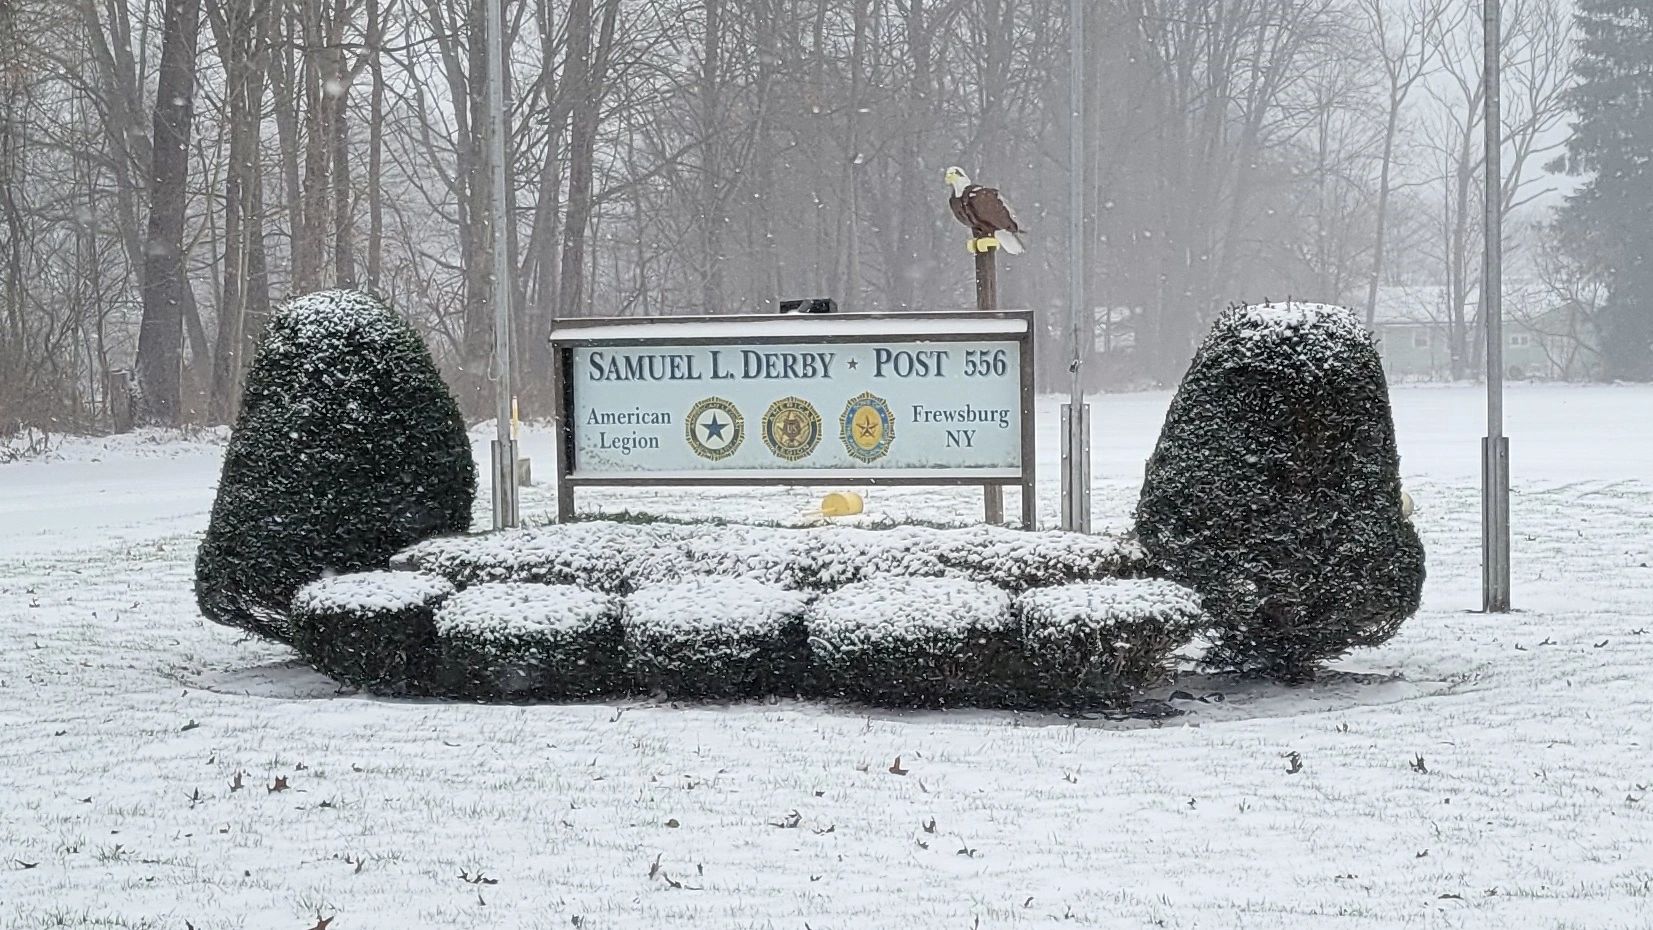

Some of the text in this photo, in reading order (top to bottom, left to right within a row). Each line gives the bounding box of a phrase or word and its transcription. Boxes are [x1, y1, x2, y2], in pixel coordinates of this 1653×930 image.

[589, 347, 1007, 381] SAMUEL L. DERBY POST 556
[586, 406, 672, 425] American
[911, 403, 1011, 429] Frewsburg
[599, 430, 660, 455] Legion
[945, 429, 977, 448] NY
